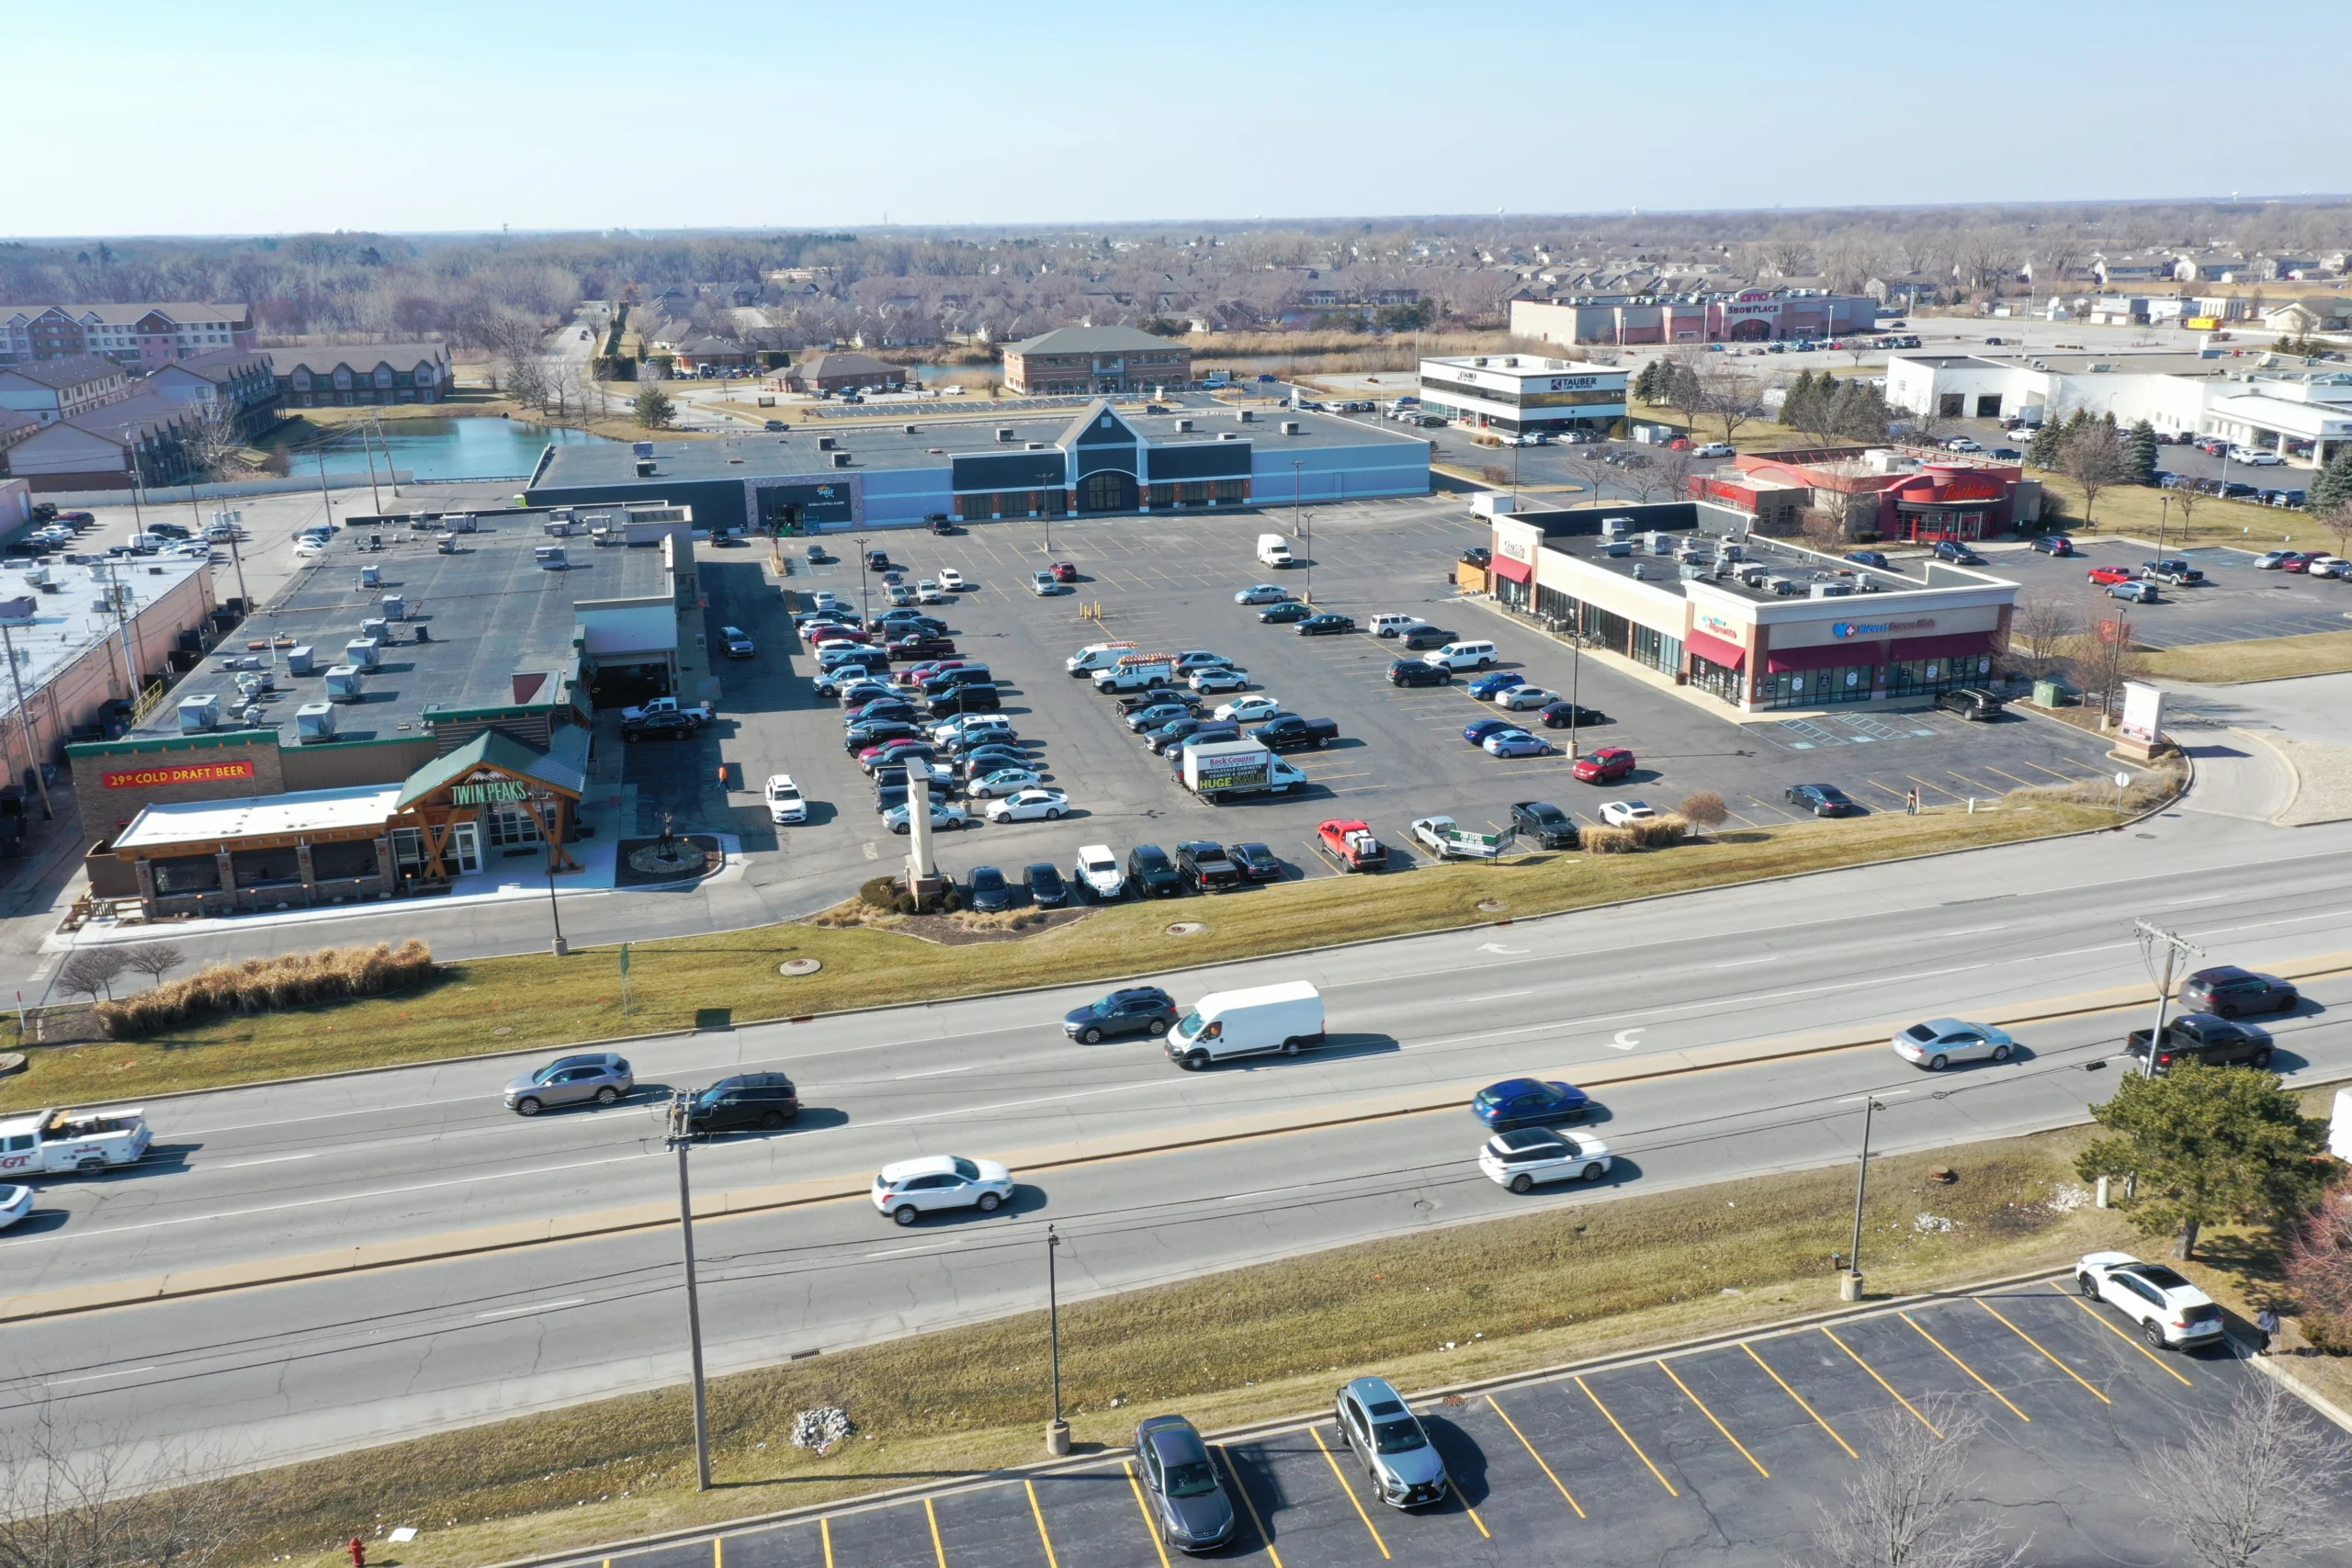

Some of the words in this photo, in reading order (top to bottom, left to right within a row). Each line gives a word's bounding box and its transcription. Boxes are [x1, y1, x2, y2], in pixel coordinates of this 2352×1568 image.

[1563, 378, 1597, 386] TAUBER
[1857, 623, 1889, 633] Midwest
[135, 772, 168, 784] COLD
[173, 768, 211, 781] DRAFT
[216, 765, 244, 777] BEER
[1199, 778, 1232, 789] HUGE
[1233, 774, 1265, 785] SALE
[451, 784, 485, 805] TWIN
[487, 781, 526, 802] PEAKS
[0, 1155, 30, 1168] GT
